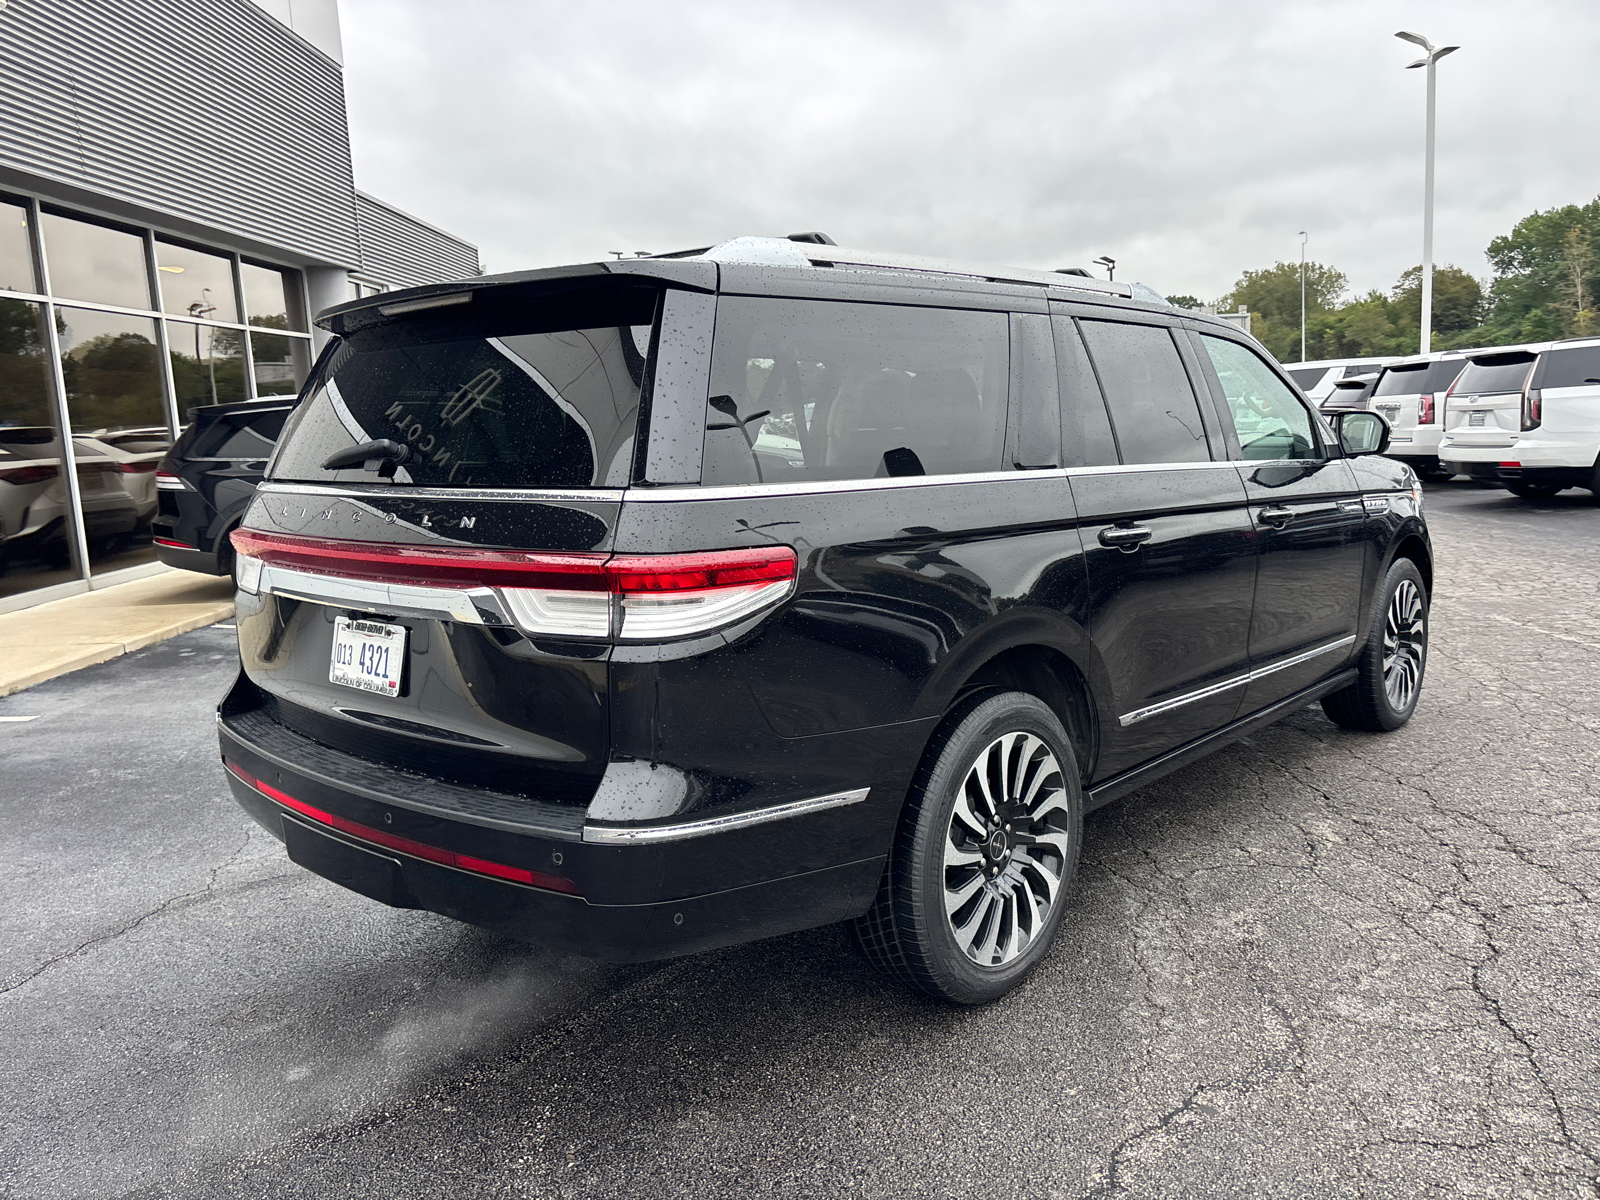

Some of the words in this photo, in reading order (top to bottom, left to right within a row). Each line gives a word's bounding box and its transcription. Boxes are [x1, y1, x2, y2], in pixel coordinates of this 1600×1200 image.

[281, 506, 476, 529] LINCOLN
[337, 643, 353, 666] 013
[359, 642, 389, 679] 4321
[332, 675, 354, 686] LINCOLN
[363, 682, 394, 695] COLUMBUS
